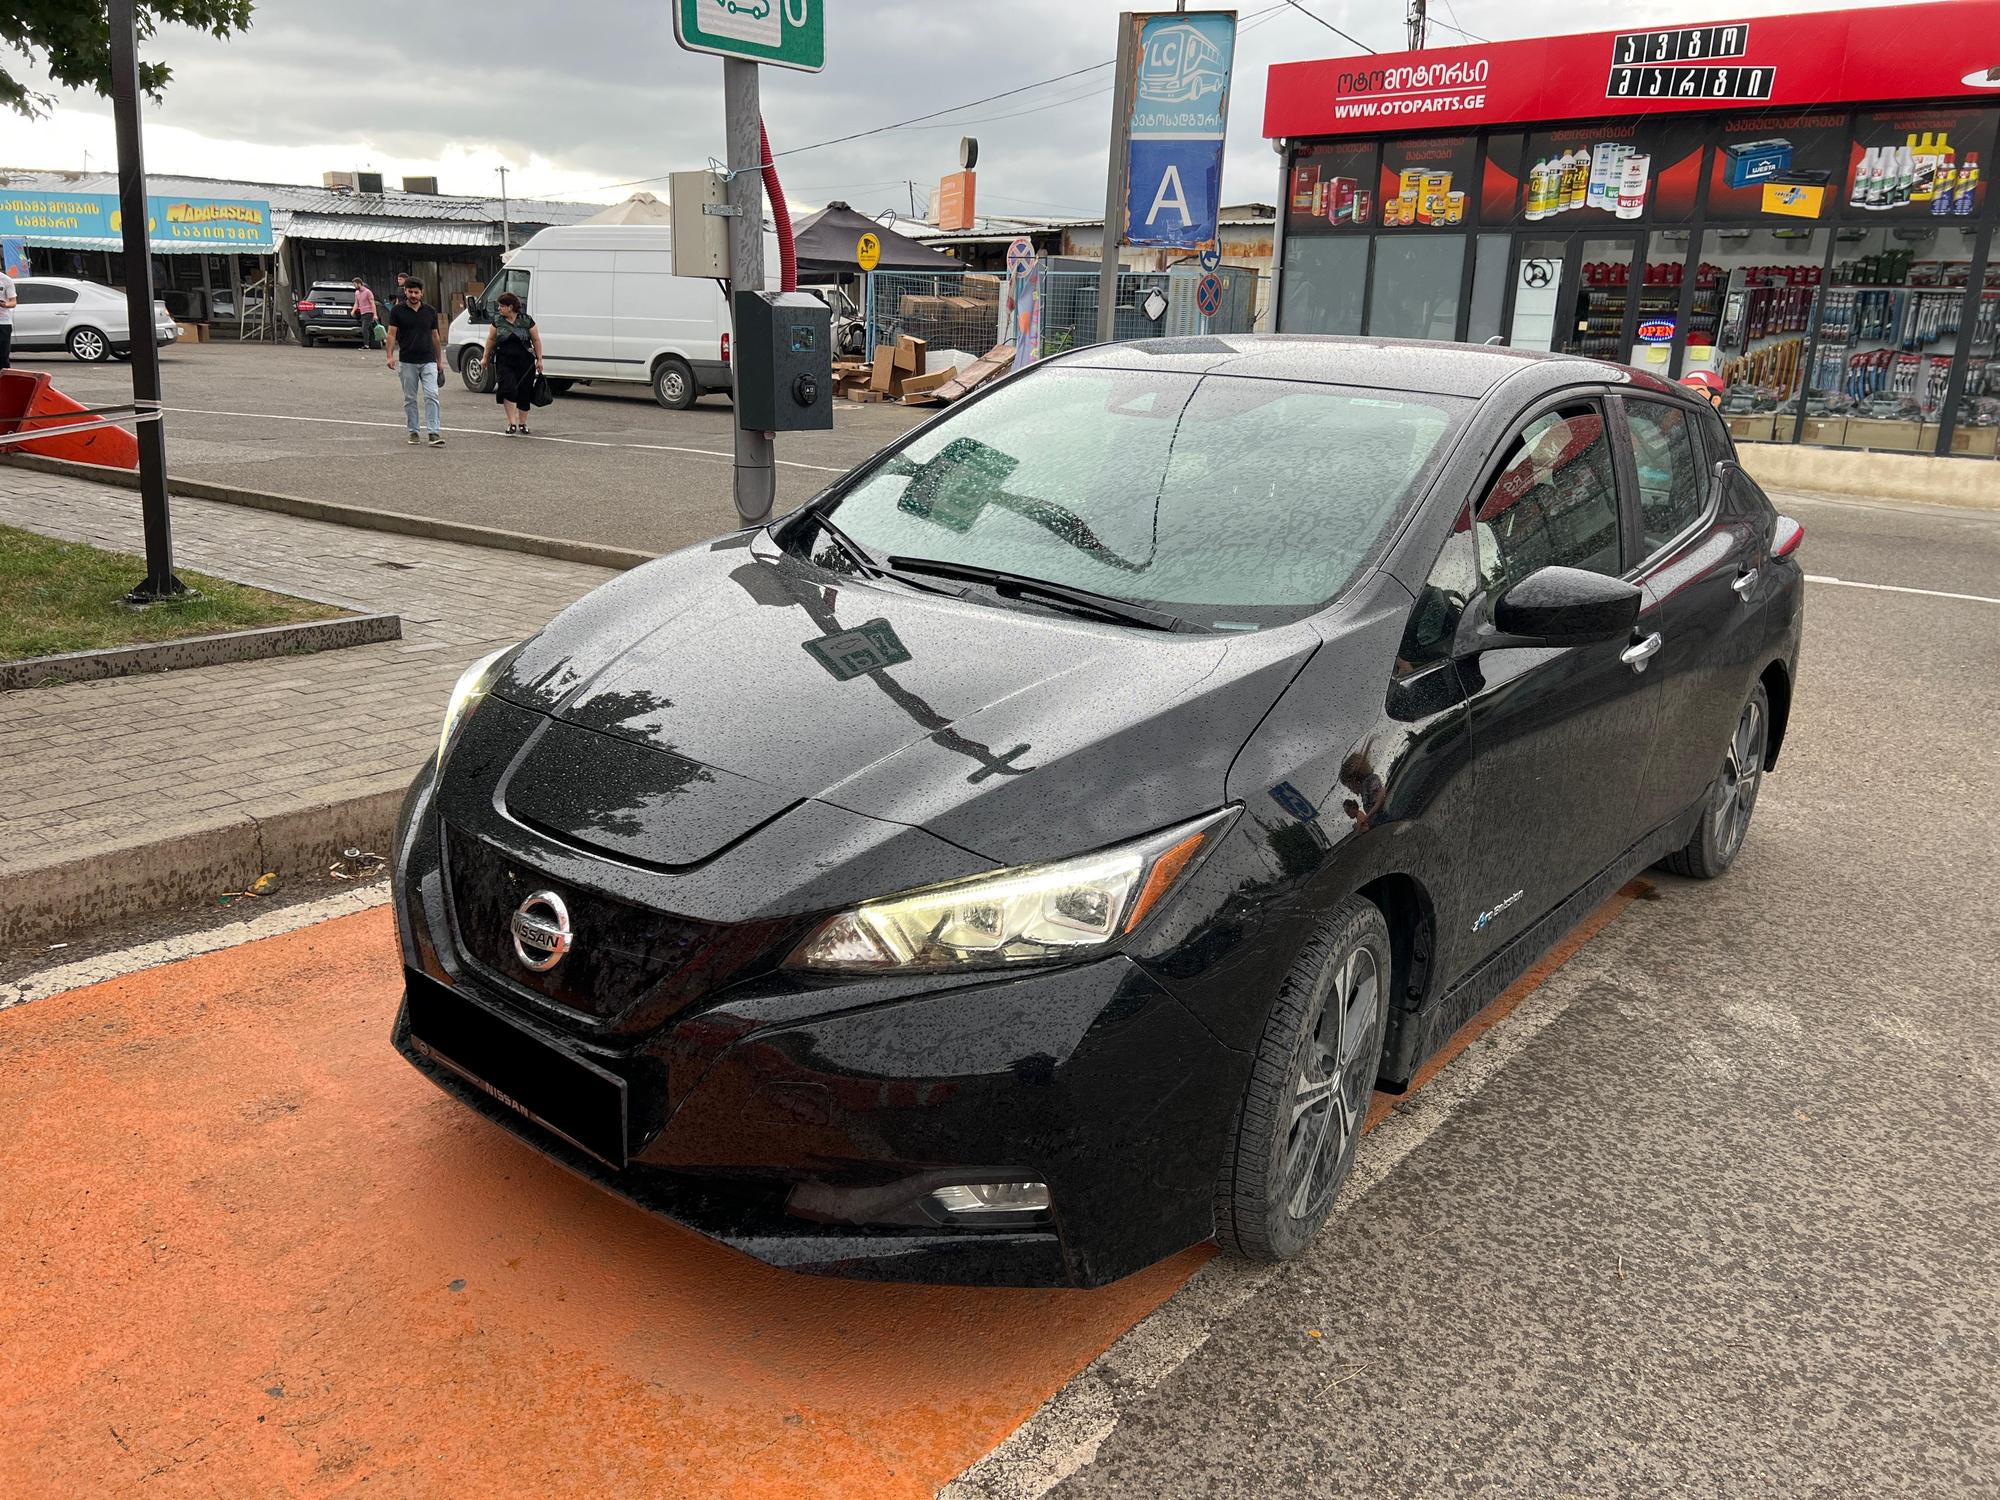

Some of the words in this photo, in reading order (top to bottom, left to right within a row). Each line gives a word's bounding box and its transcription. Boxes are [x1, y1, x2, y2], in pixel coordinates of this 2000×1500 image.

[1150, 42, 1177, 67] LC
[1623, 27, 1738, 63] ავტო
[1337, 59, 1489, 93] ოტომოტორსი
[1618, 69, 1762, 96] მარტი
[1334, 94, 1486, 119] WWW.OTOPARTS.GE
[1752, 163, 1776, 173] WESTA
[1145, 165, 1193, 226] A
[1638, 326, 1675, 337] OPEN
[512, 917, 560, 948] NISSAN
[484, 1082, 529, 1118] NISSAN
